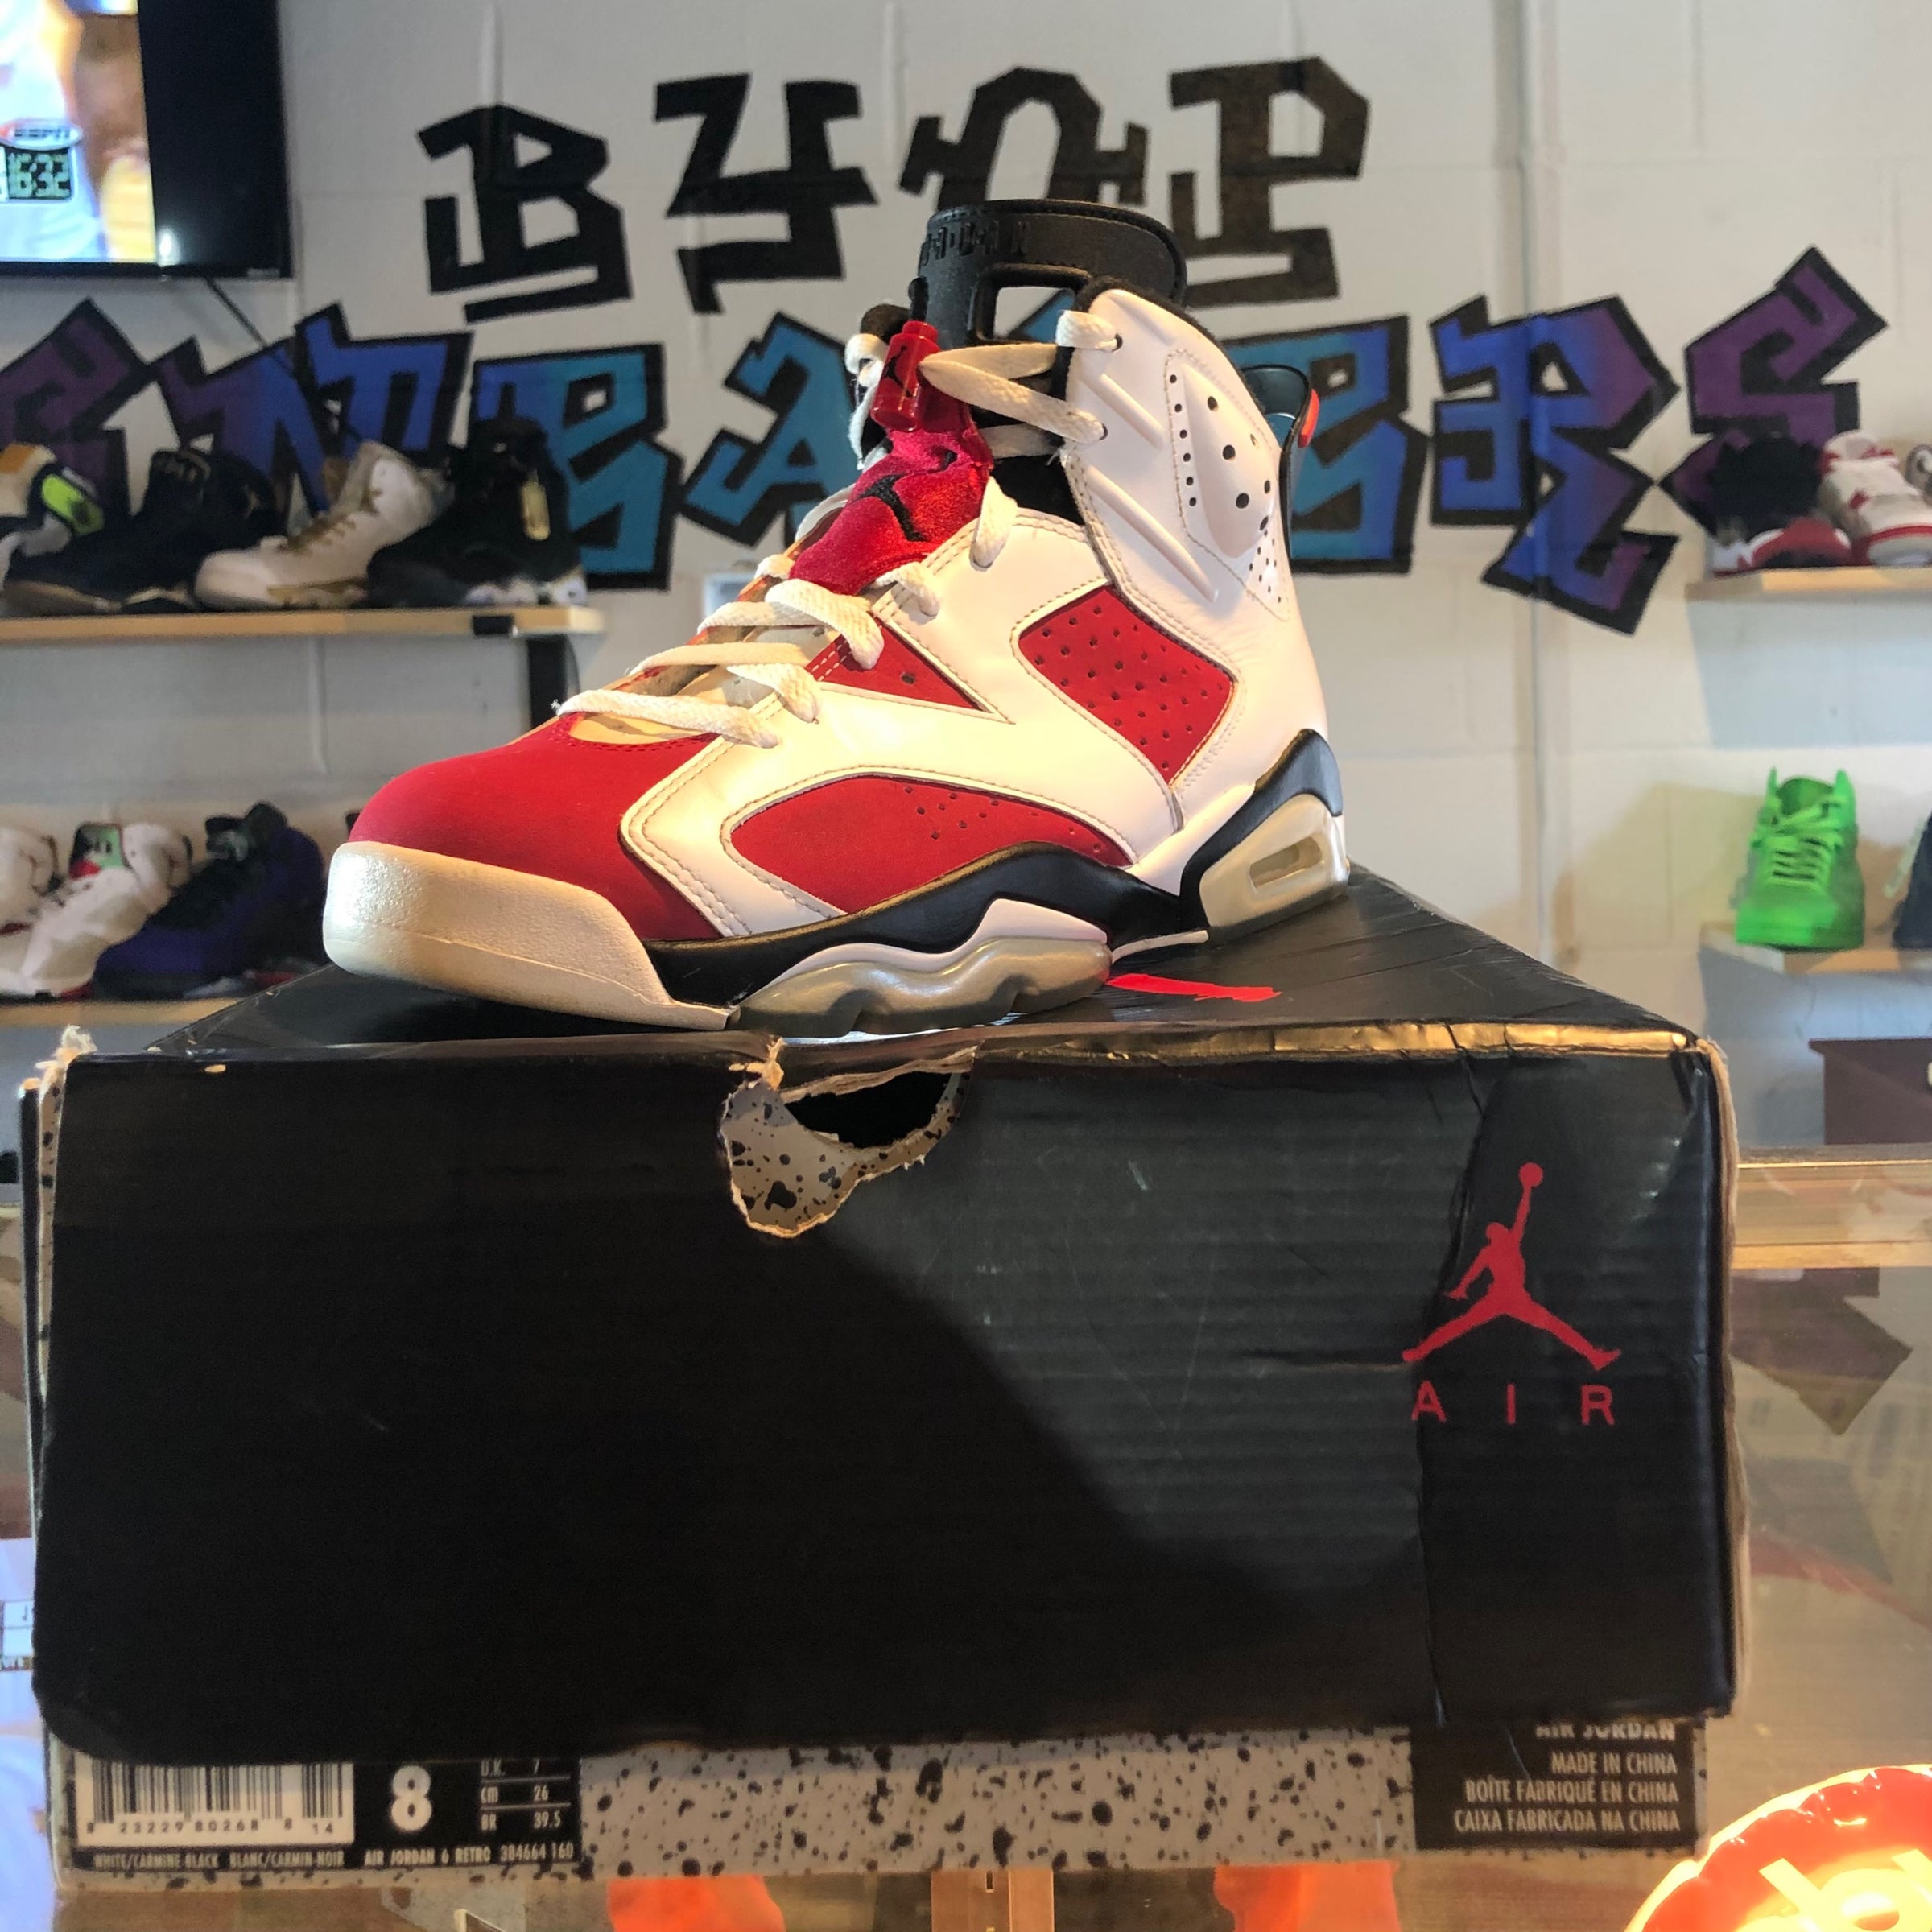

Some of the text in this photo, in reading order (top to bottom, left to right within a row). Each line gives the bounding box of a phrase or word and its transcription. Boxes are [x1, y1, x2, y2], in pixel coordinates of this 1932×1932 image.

[14, 127, 72, 139] ESPN
[1410, 1380, 1616, 1426] AIR
[1550, 1751, 1678, 1776] MADE IN CHINA
[390, 1764, 433, 1832] 8
[533, 1784, 550, 1802] 26
[1464, 1773, 1680, 1805] BOÎTE FABRIQUÉ EN CHINA
[312, 1821, 334, 1835] 14
[533, 1810, 562, 1829] 39.5
[1454, 1807, 1682, 1833] CAIXA FABRICADA NA CHINA
[363, 1848, 385, 1867] AIR
[390, 1847, 436, 1866] JORDAN
[454, 1845, 492, 1864] RETRO
[551, 1840, 574, 1860] 160
